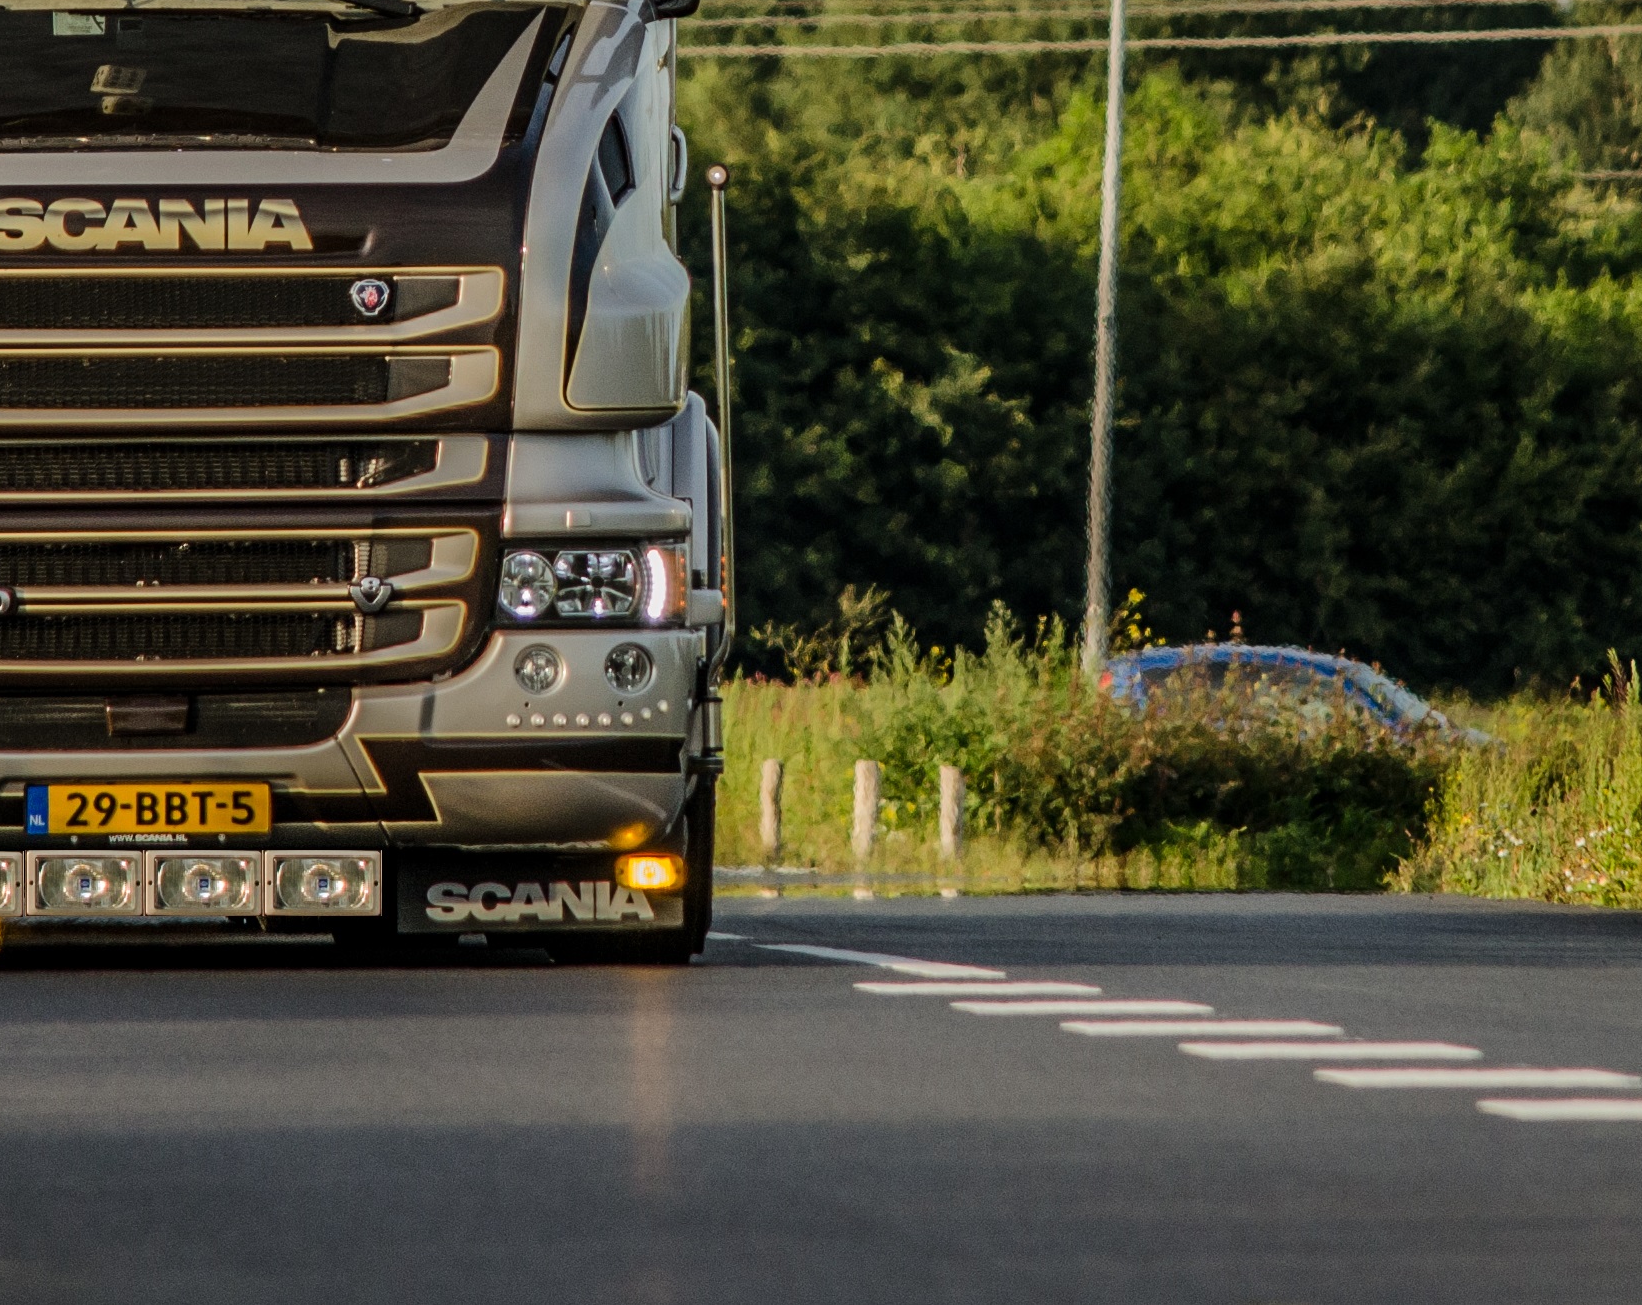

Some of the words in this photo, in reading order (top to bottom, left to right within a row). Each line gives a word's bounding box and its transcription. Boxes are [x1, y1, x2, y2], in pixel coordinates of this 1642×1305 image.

[29, 814, 45, 826] NL
[66, 791, 256, 827] 29-BBT-5
[426, 881, 654, 921] SCANIA
